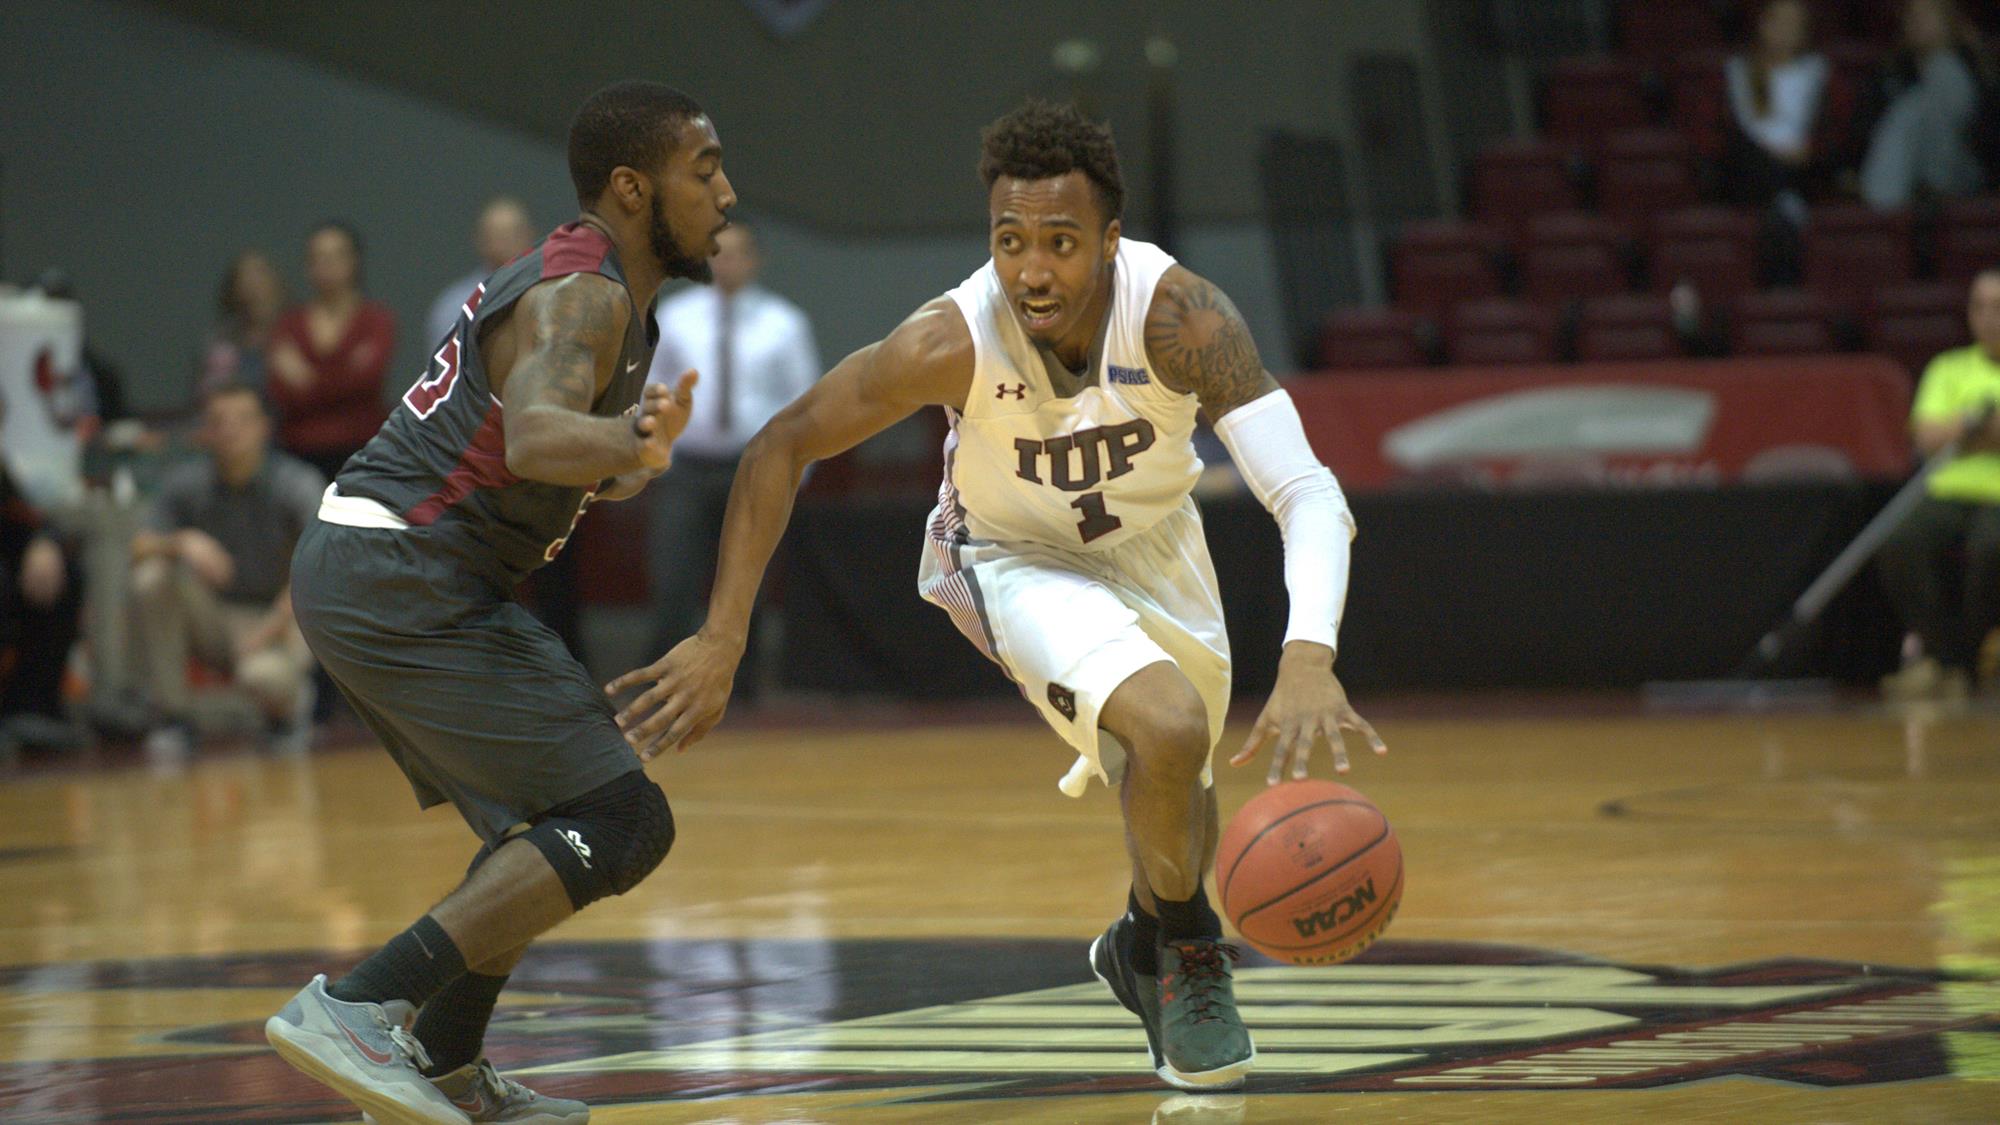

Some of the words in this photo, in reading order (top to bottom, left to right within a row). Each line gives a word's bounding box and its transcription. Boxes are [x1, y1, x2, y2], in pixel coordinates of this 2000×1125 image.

[1107, 364, 1151, 385] PSAC
[1014, 417, 1156, 492] IUP
[1070, 491, 1122, 545] 1
[1292, 876, 1378, 938] NCAA
[1393, 1022, 1913, 1084] CRIMSON
